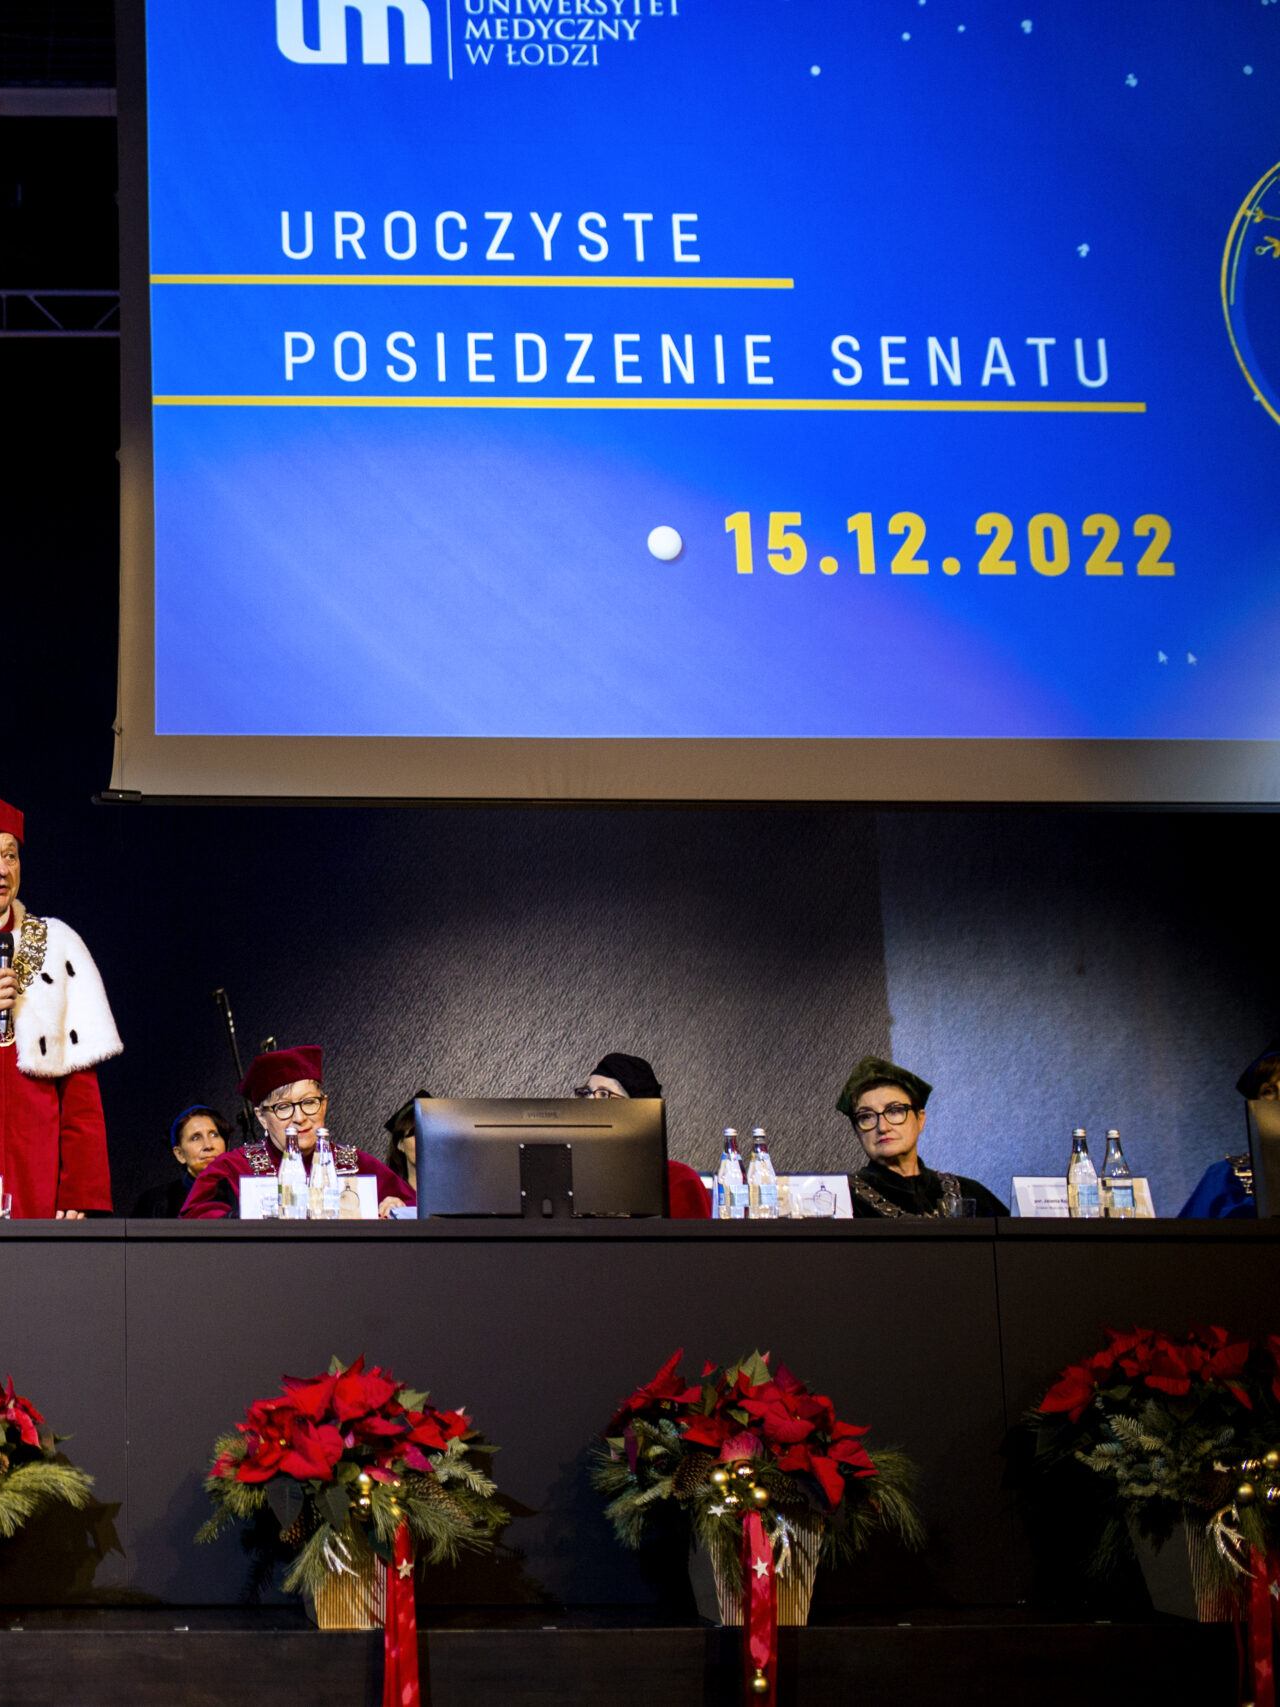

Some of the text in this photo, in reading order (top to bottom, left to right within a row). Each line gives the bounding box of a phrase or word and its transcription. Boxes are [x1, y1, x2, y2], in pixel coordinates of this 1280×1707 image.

[465, 19, 640, 41] MEDYCZNY
[465, 43, 599, 66] W ŁODZI
[281, 210, 701, 262] UROCZYSTE
[284, 330, 1109, 388] POSIEDZENIE SENATU
[724, 510, 1175, 577] 15.12.2022
